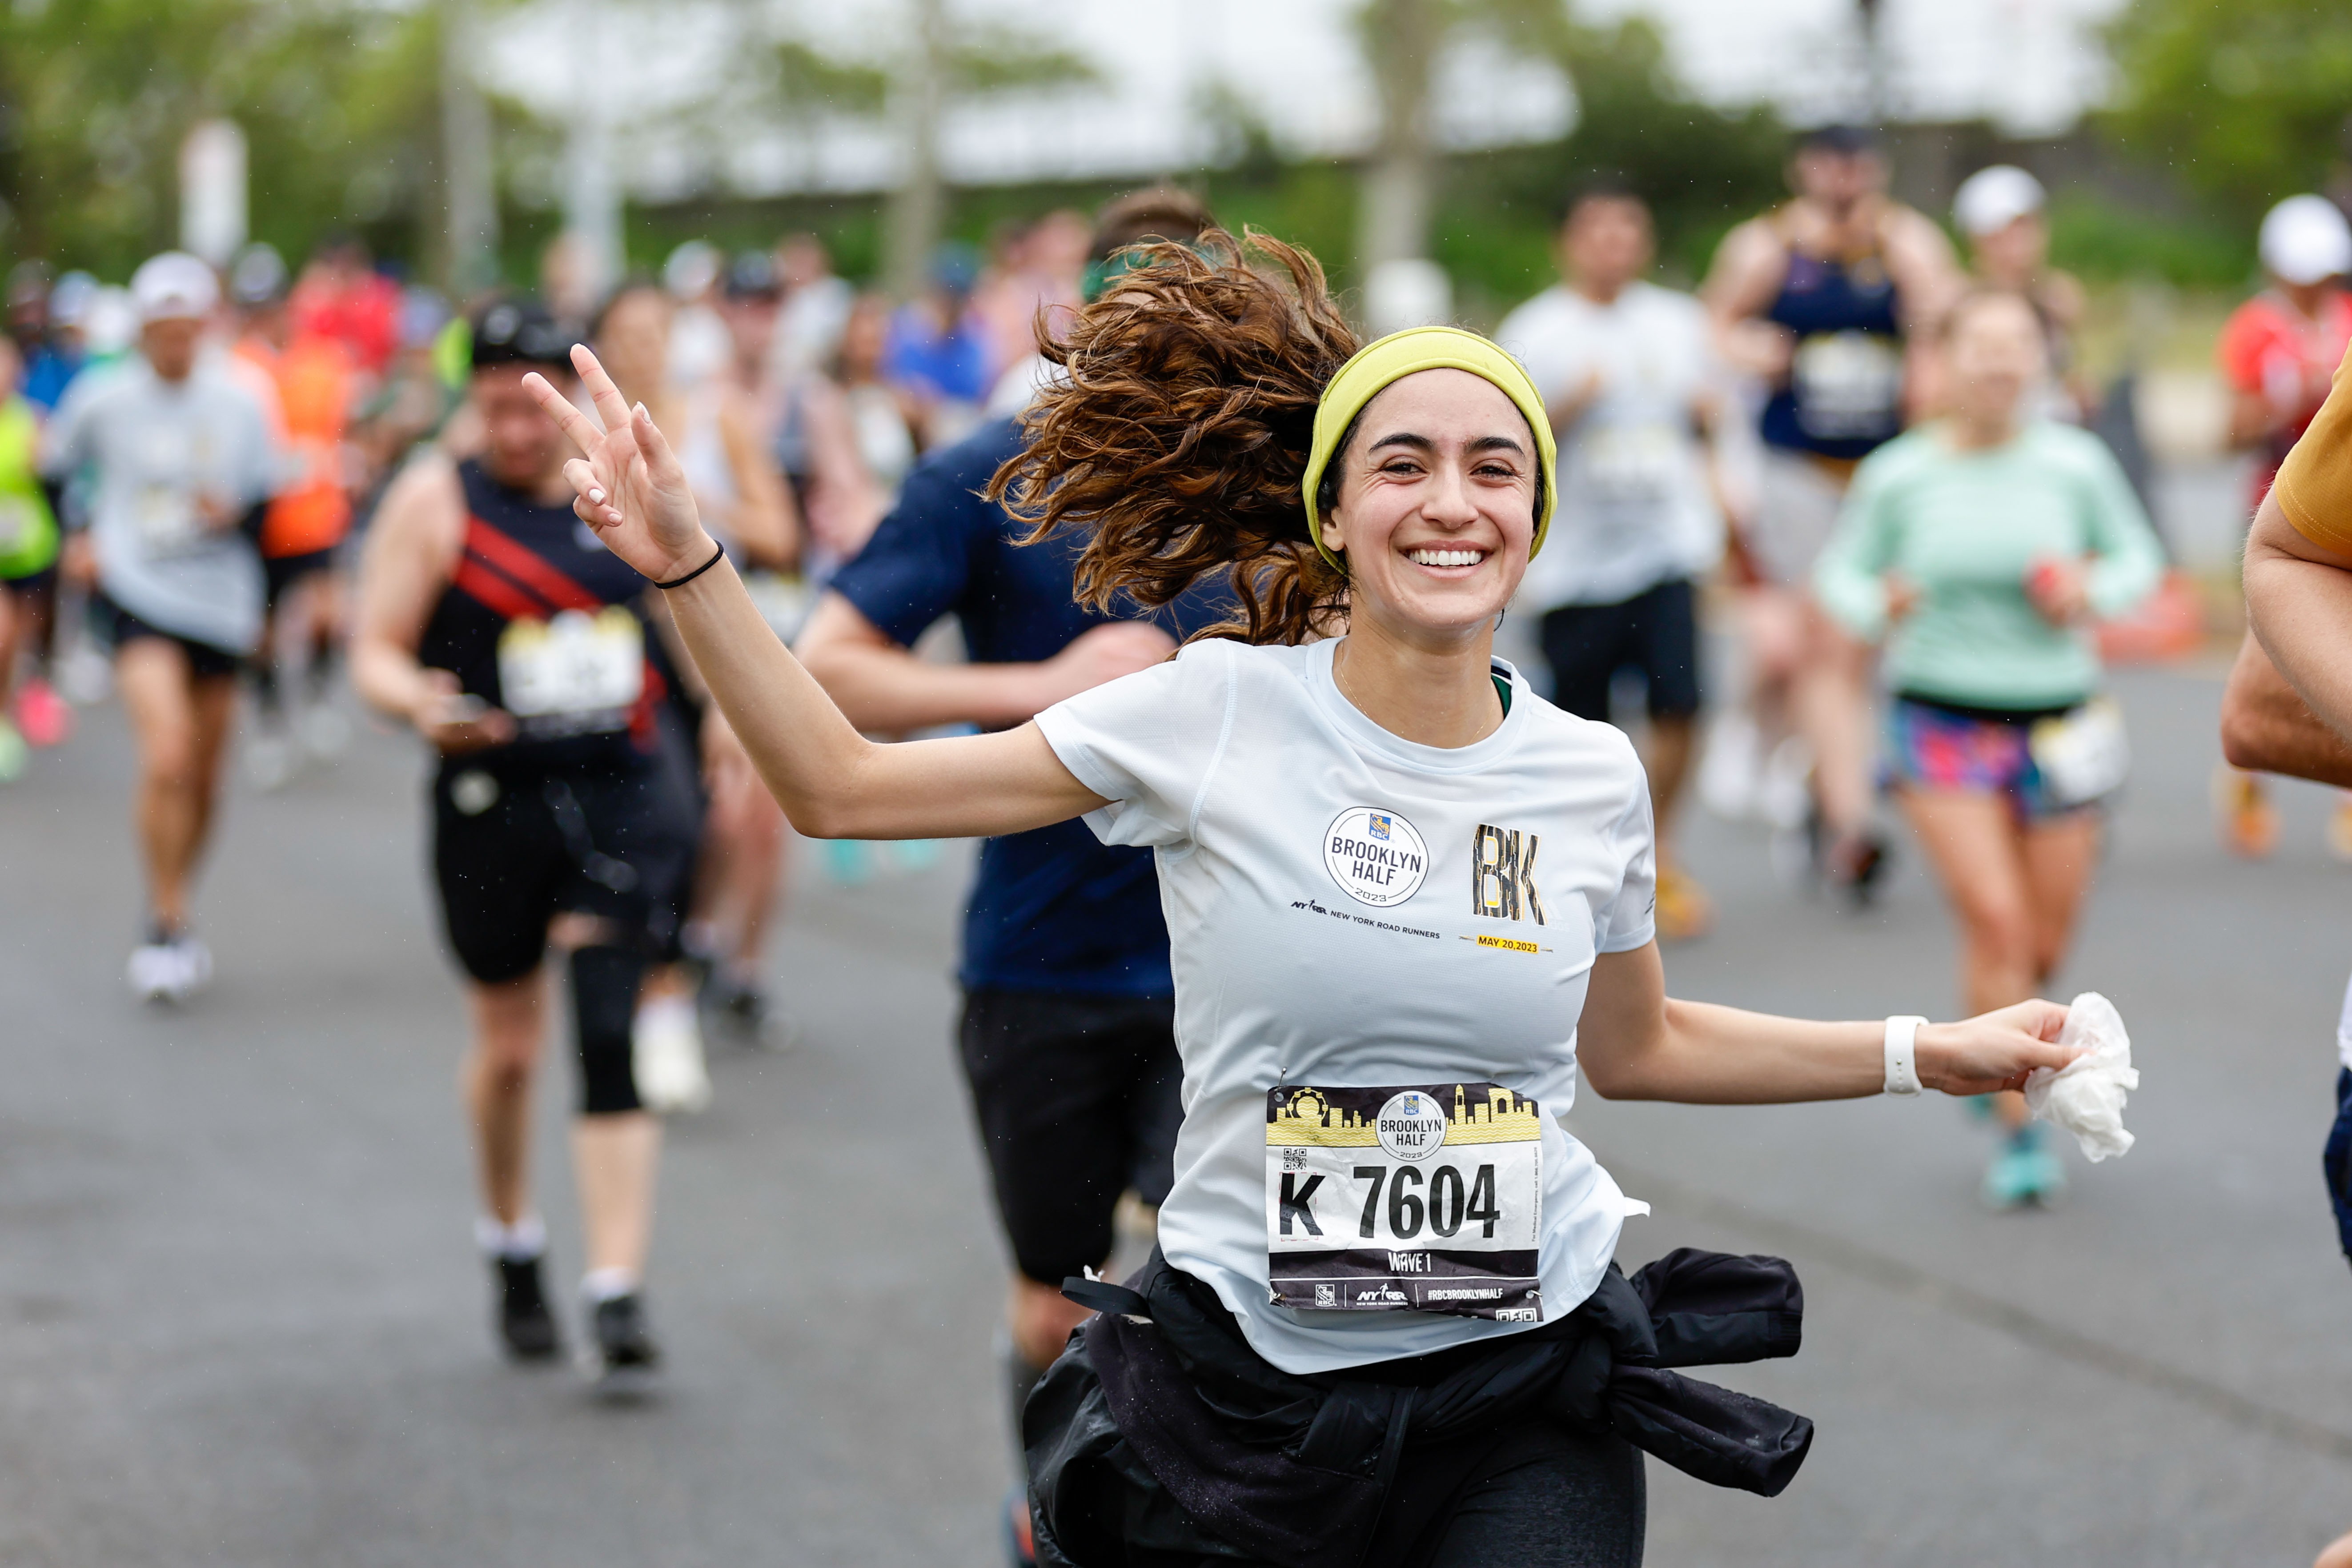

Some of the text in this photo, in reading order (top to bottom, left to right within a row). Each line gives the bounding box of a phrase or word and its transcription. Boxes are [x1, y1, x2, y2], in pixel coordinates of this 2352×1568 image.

[1370, 829, 1389, 841] RBC
[1332, 836, 1421, 873] BROOKLYN
[1352, 860, 1396, 886] HALF
[1355, 887, 1387, 902] 2023
[1330, 910, 1441, 939] NEW YORK ROAD RUNNERS
[1478, 936, 1537, 953] MAY 20,2023
[1381, 1119, 1442, 1133] BROOKLYN
[1396, 1134, 1426, 1146] HALF
[1279, 1163, 1501, 1239] K 7604
[1387, 1251, 1431, 1272] WAVE 1
[1427, 1288, 1503, 1301] #RBCBROOKLYNHALF
